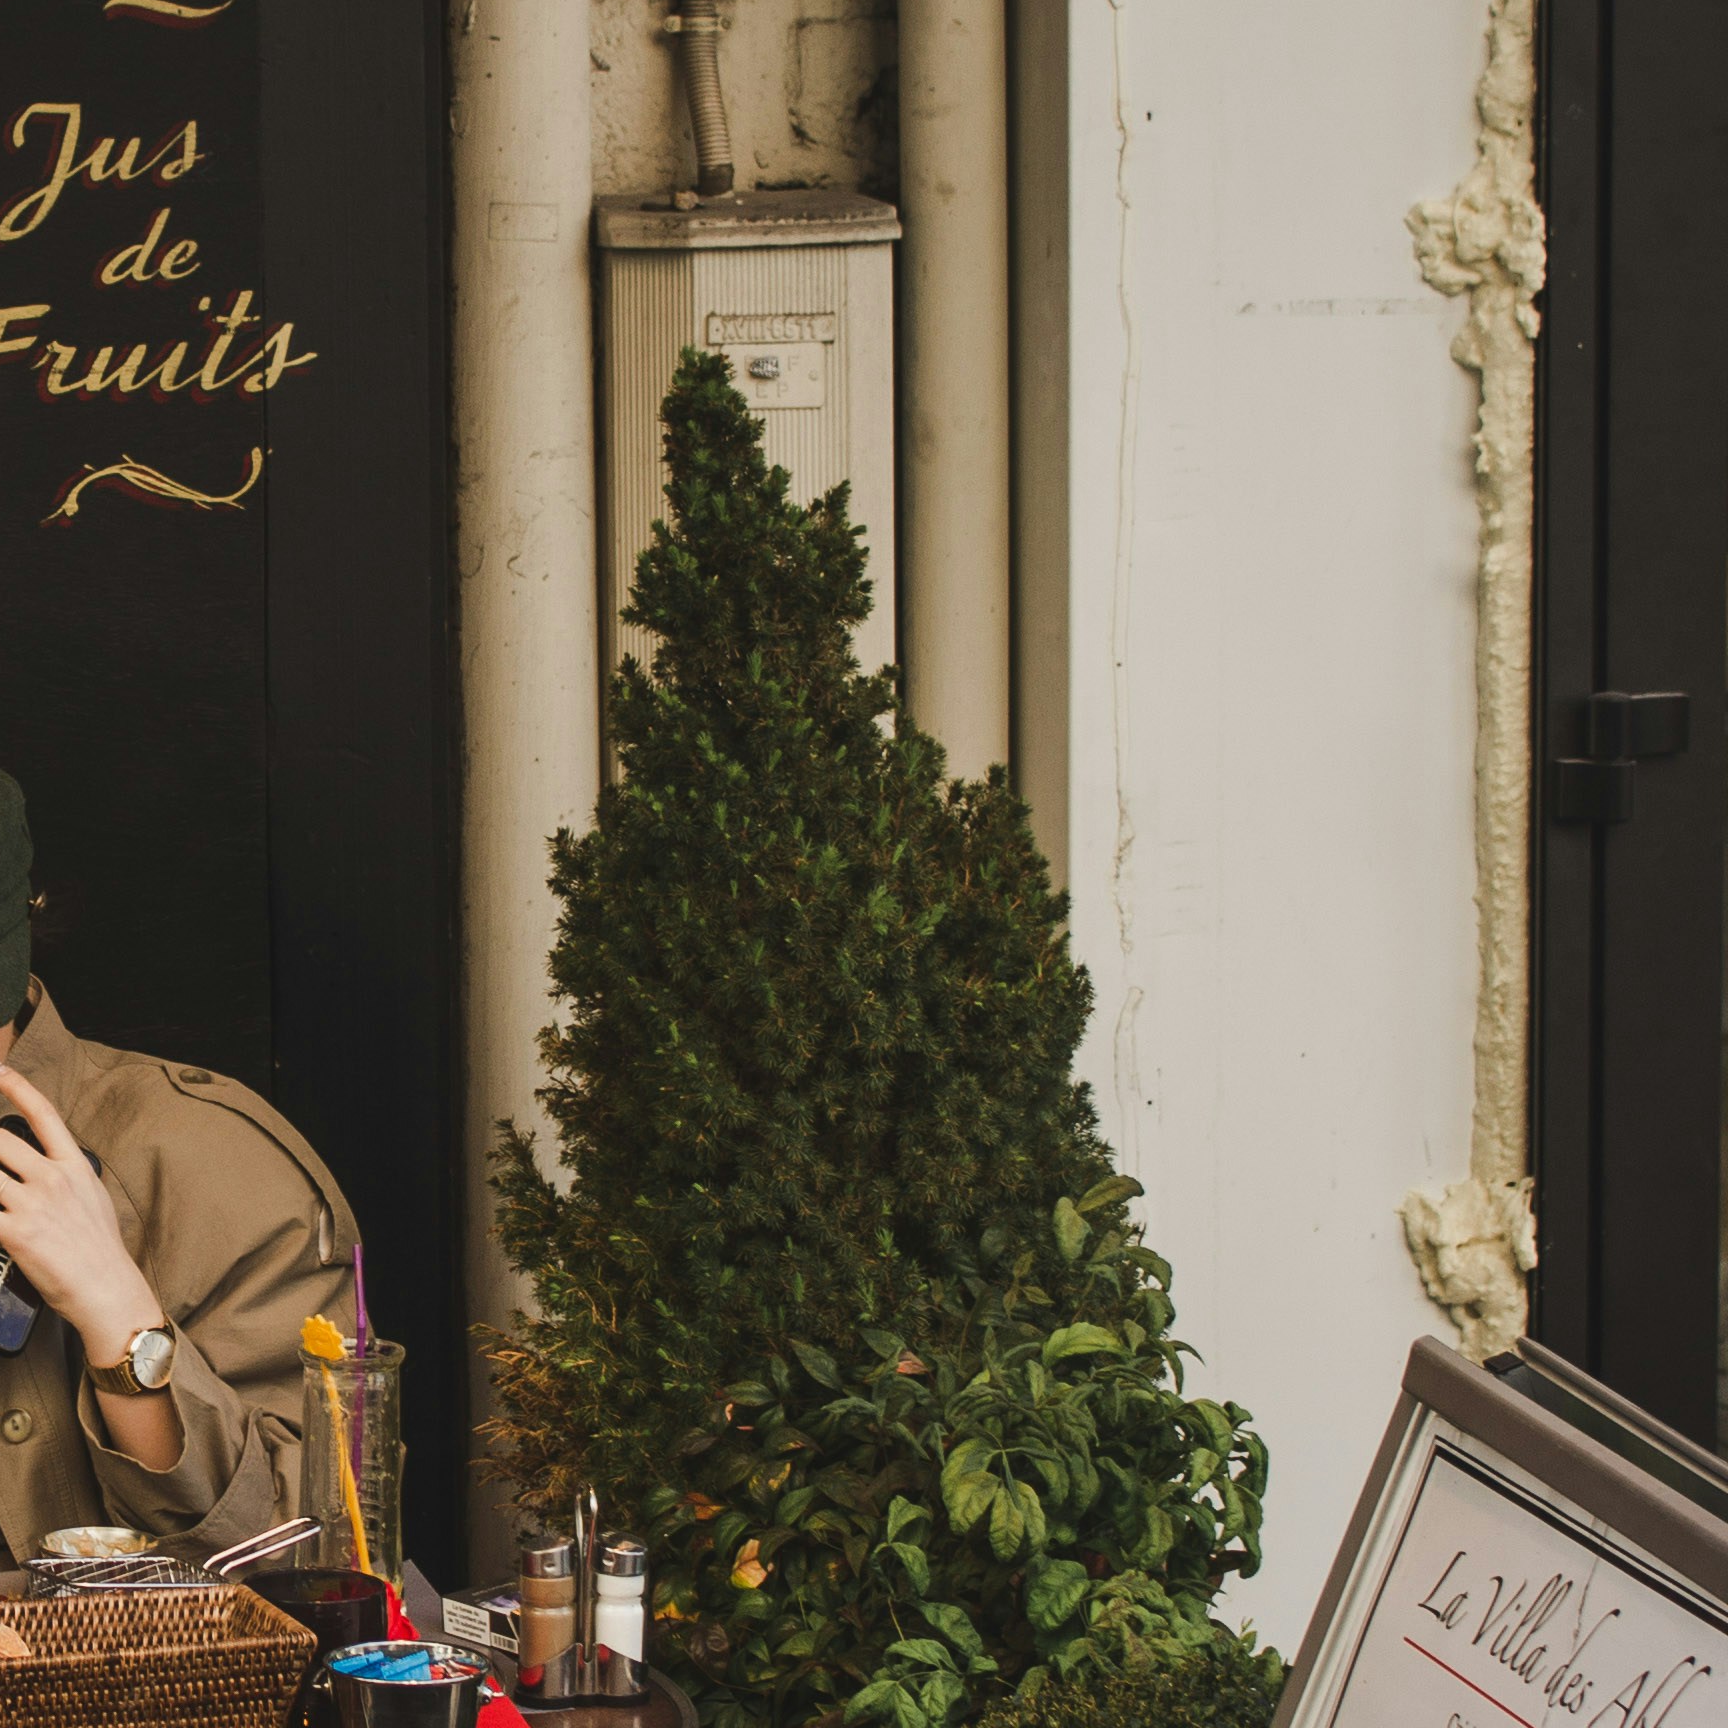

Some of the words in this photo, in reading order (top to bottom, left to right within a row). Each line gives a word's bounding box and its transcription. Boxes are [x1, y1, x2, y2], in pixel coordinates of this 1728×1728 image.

[97, 208, 200, 286] de
[1417, 1550, 1469, 1631] La
[1471, 1572, 1574, 1685] Villa
[1544, 1608, 1623, 1715] des
